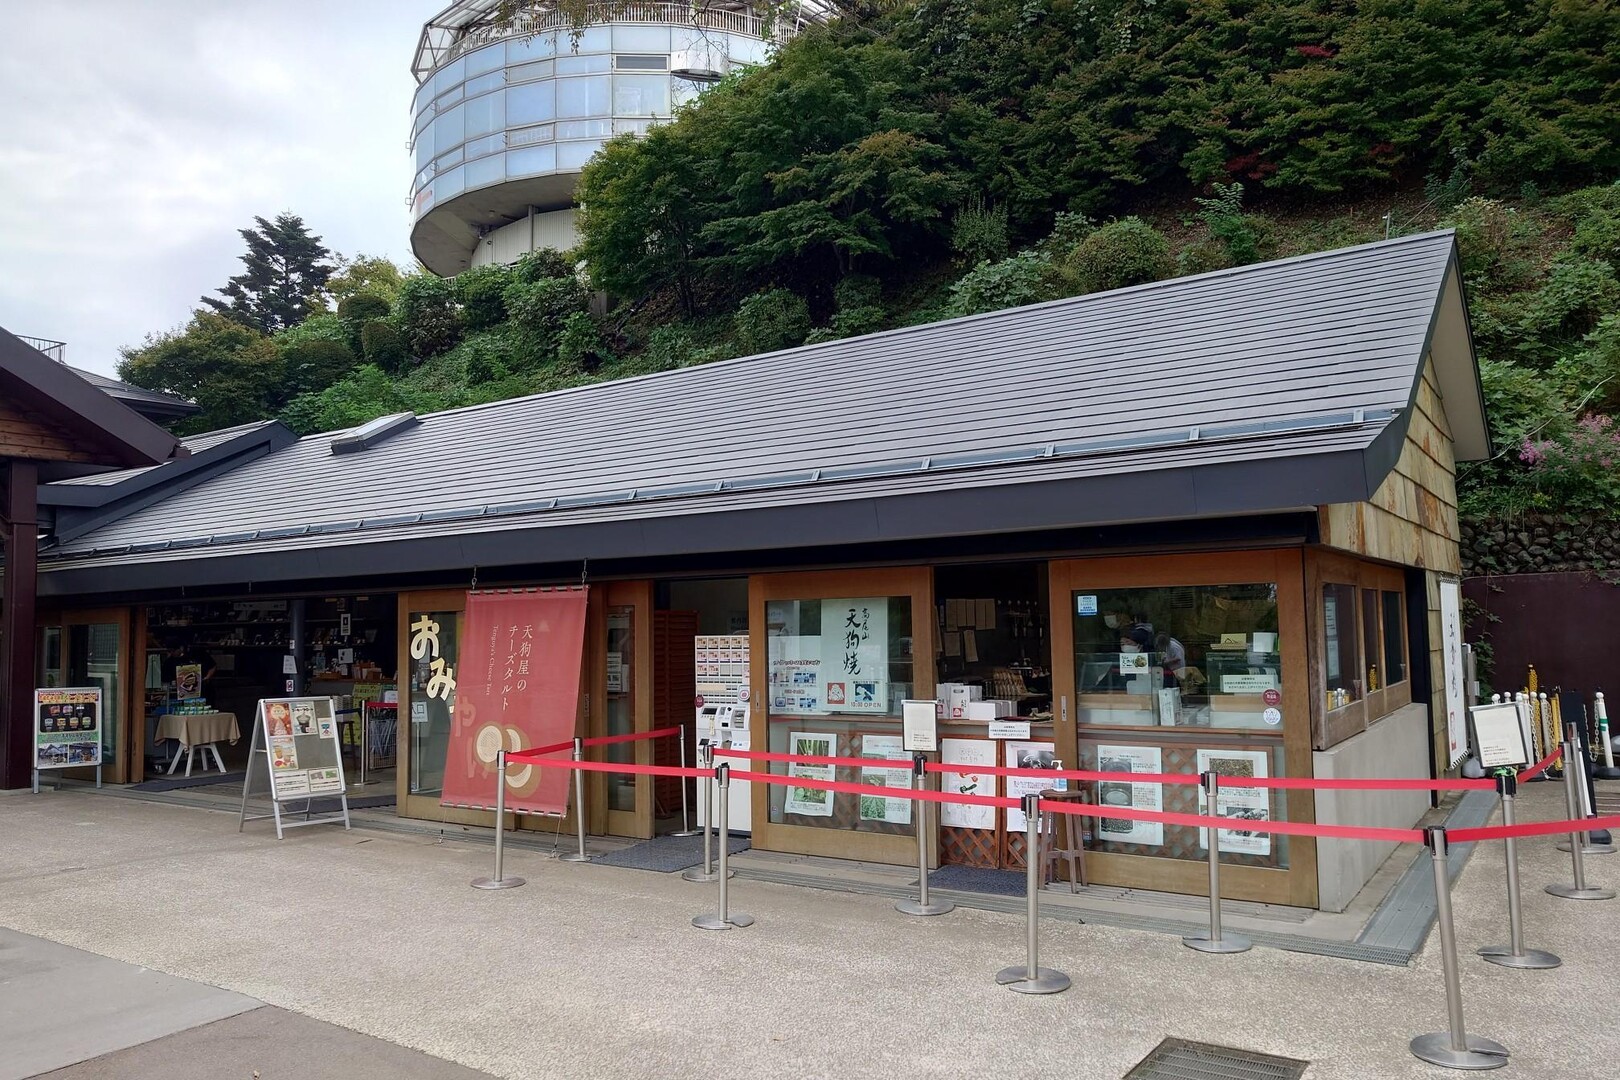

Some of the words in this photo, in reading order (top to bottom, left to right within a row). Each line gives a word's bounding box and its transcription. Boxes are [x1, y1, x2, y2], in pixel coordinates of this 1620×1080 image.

[843, 609, 861, 676] 天狗焼
[861, 608, 870, 640] 高尾山
[487, 657, 495, 681] Cheese
[501, 625, 518, 711] チーズタルト
[516, 624, 533, 692] 天狗屋の
